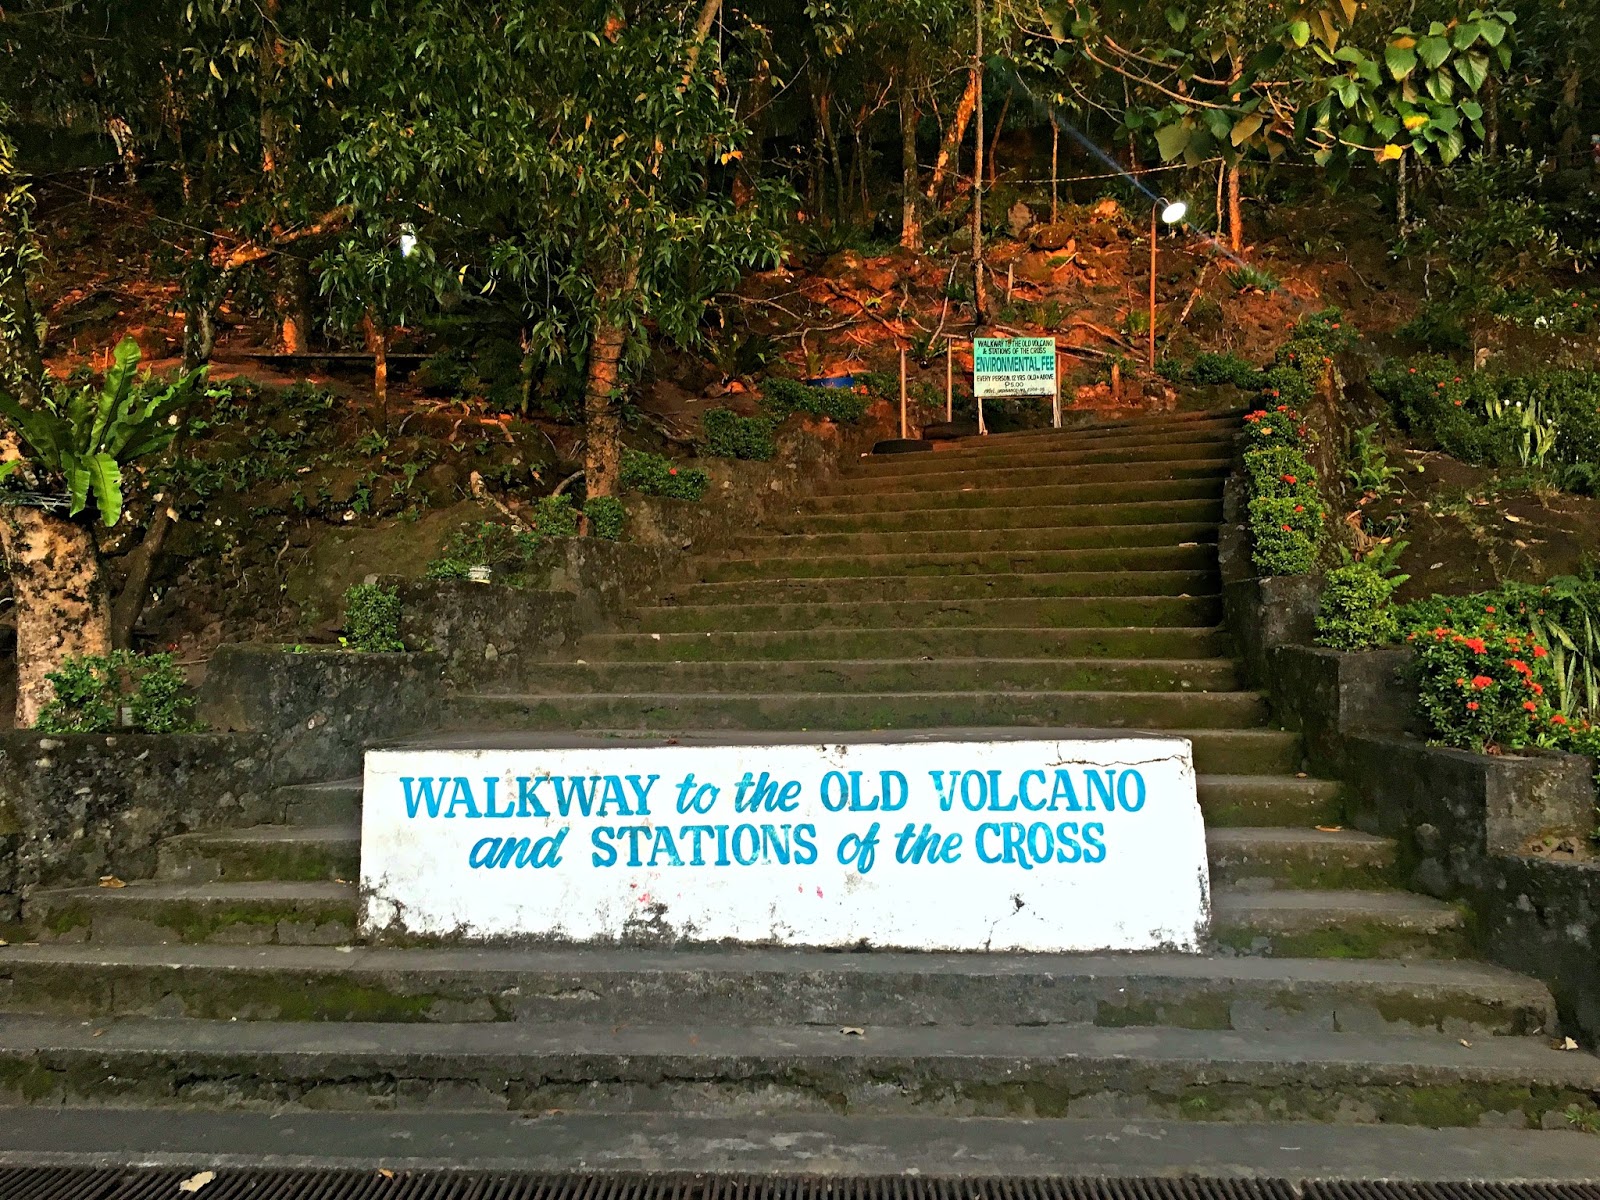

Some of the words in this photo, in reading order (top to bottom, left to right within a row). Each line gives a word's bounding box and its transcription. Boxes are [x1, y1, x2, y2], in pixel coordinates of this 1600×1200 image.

[1022, 339, 1031, 347] OLD
[1032, 339, 1053, 347] VOLCANO
[976, 356, 1040, 372] ENVIRONMENTAL
[1041, 355, 1054, 371] FEE
[400, 774, 660, 818] WALKWAY
[676, 773, 720, 814] to
[735, 771, 801, 813] the
[820, 770, 909, 813] OLD
[928, 769, 1146, 812] VOLCANO
[468, 826, 569, 869] and
[592, 823, 818, 868] STATIONS
[837, 822, 881, 874] of
[895, 822, 963, 864] the
[975, 821, 1107, 870] CROSS
